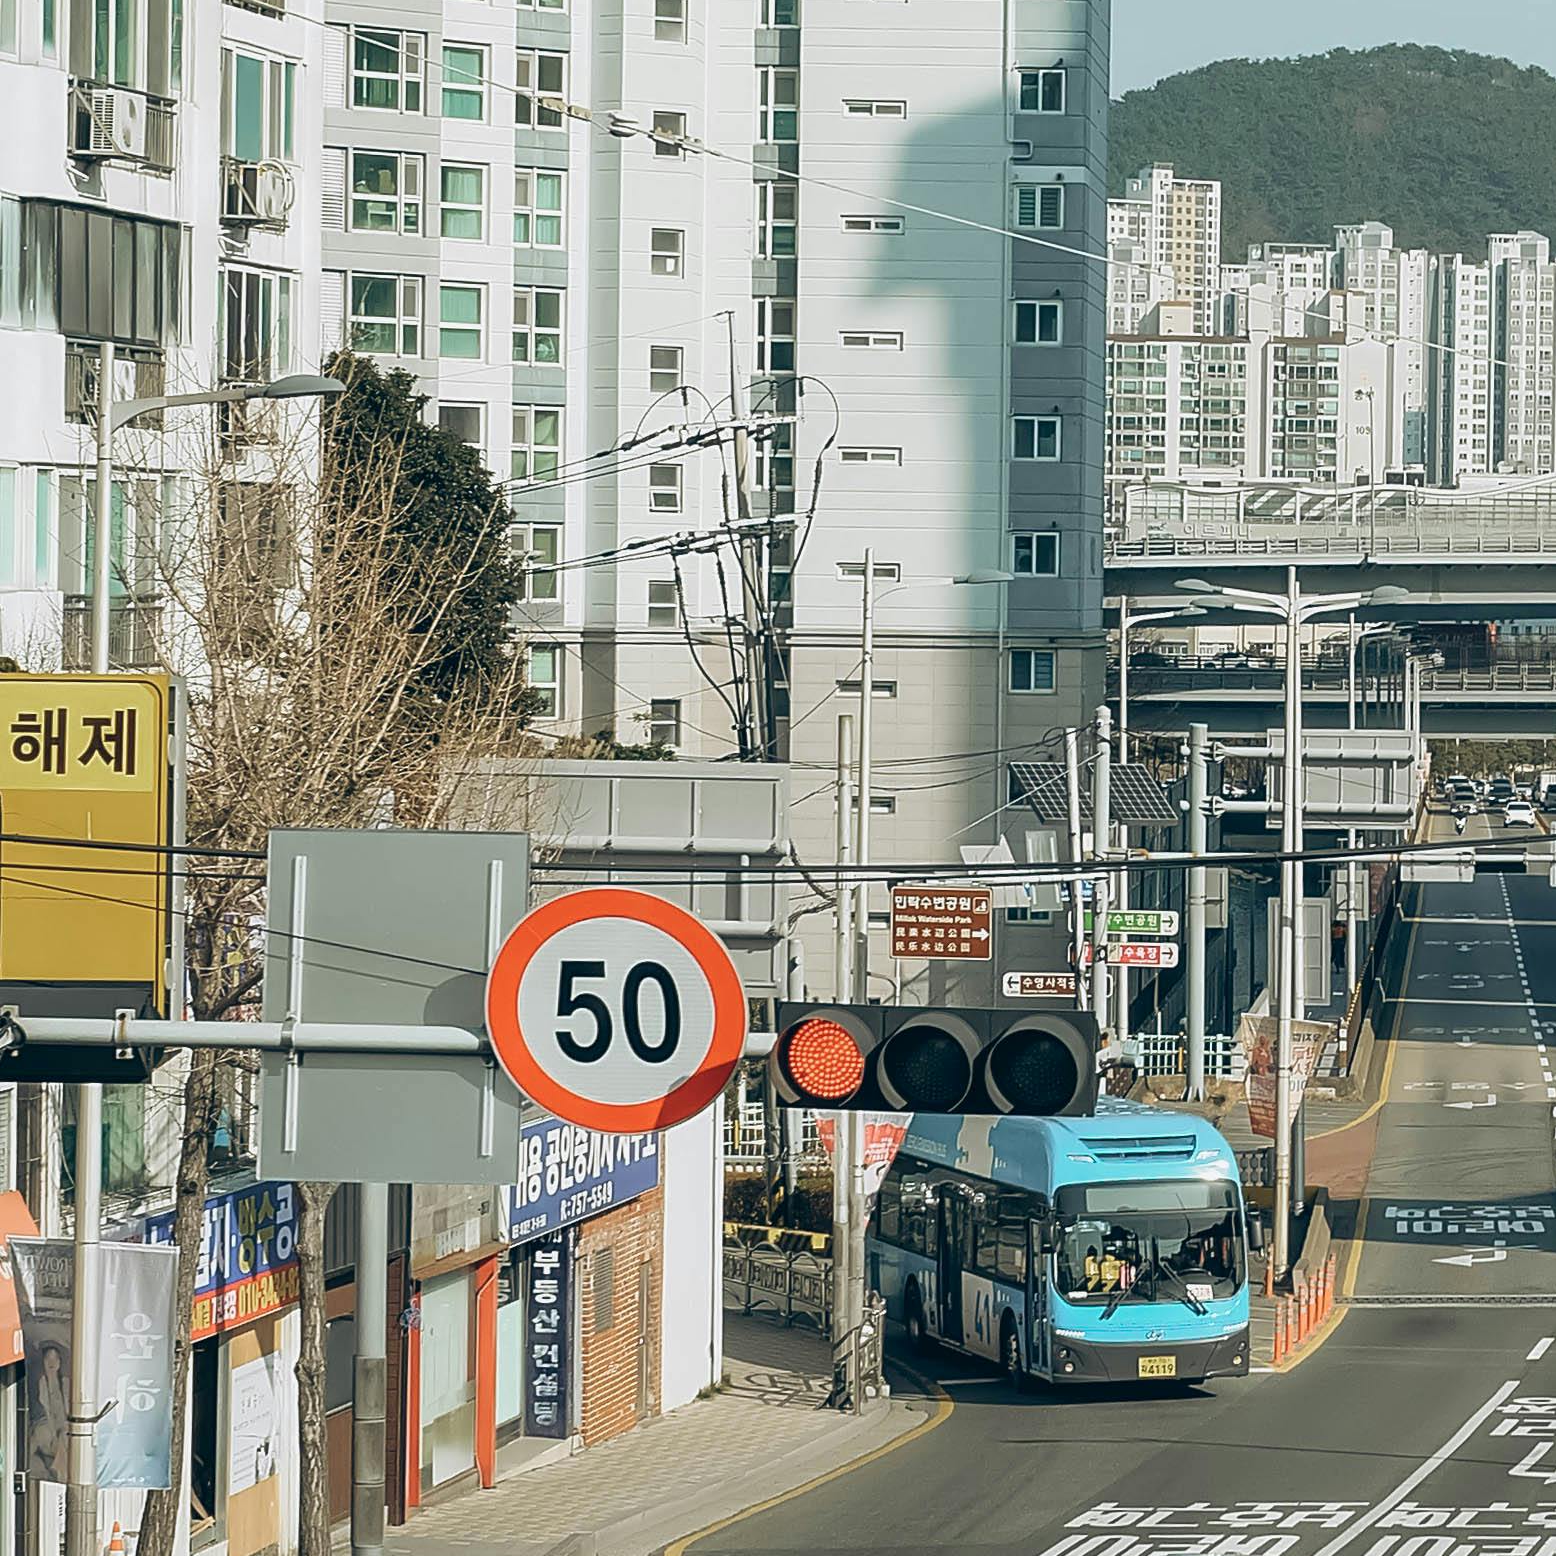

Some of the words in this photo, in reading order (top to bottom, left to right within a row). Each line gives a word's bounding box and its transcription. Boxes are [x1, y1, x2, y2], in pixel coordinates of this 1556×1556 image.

[11, 708, 138, 777] 해제
[895, 896, 971, 911] 민락수변공원
[555, 961, 682, 1064] 50
[532, 1250, 560, 1334] 부동산
[1066, 1501, 1369, 1529] 보호구역
